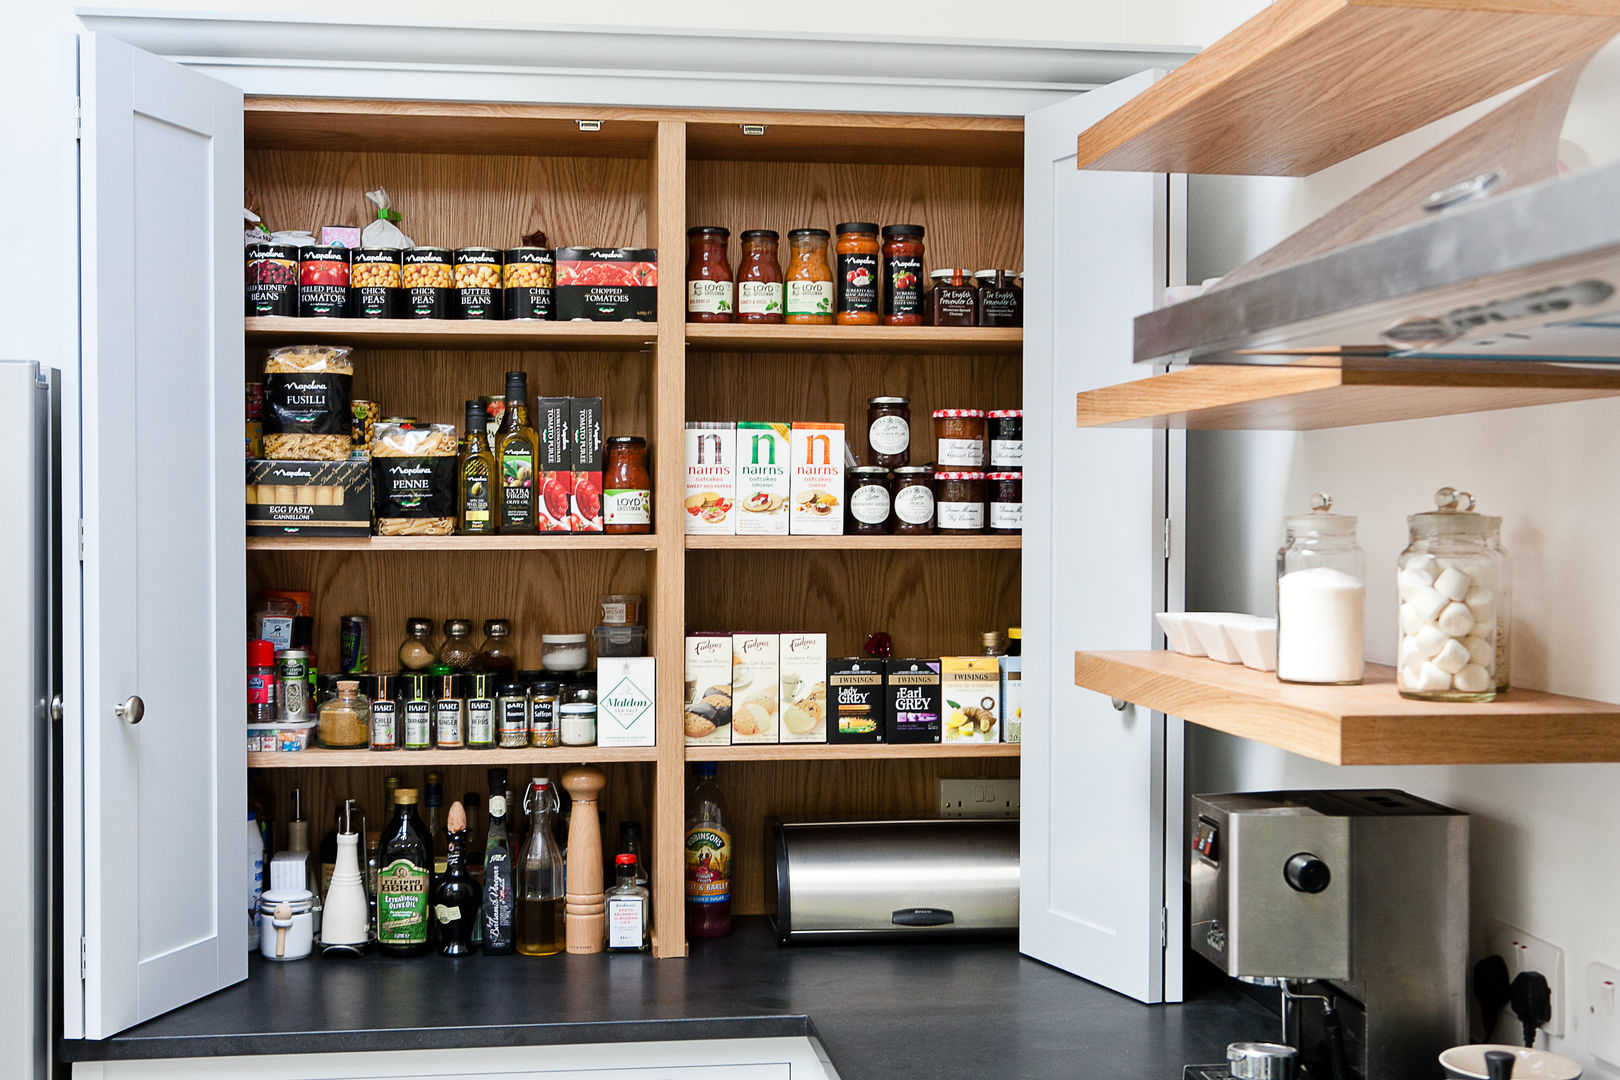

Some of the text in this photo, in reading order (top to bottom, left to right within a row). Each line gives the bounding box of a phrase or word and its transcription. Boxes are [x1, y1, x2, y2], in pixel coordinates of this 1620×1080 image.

[249, 248, 285, 259] Napolina
[304, 250, 342, 260] Napolina
[355, 252, 393, 262] Napolina
[406, 252, 442, 263] Napolina
[458, 253, 495, 263] Napolina
[361, 287, 386, 295] CHICK
[943, 290, 971, 299] The English
[995, 291, 1014, 299] English
[251, 292, 279, 301] BEANS
[302, 294, 346, 303] TOMATOES
[362, 296, 385, 304] PEAS
[412, 296, 434, 304] PEAS
[461, 296, 491, 305] BEANS
[530, 296, 550, 305] PEAS
[940, 297, 965, 305] Provender
[983, 298, 1008, 306] Provender
[284, 380, 327, 391] Napolina
[286, 395, 325, 404] FUSILLI
[697, 434, 722, 465] n
[751, 434, 776, 465] n
[806, 434, 830, 465] n
[273, 468, 311, 478] Napolina
[389, 464, 432, 476] Napolina
[688, 465, 730, 475] nairn's
[742, 465, 784, 475] nairn's
[797, 465, 839, 475] nairn's
[393, 479, 429, 489] PENNE
[616, 498, 641, 506] LOYD
[269, 506, 314, 514] EGG PASTA
[954, 673, 989, 681] TWININGS
[838, 687, 858, 695] Lady
[900, 687, 922, 699] Earl
[607, 698, 647, 708] Maldon
[838, 692, 870, 704] GREY
[895, 698, 932, 710] GREY
[687, 832, 723, 847] ROBINSONS
[706, 882, 728, 891] BARLEY
